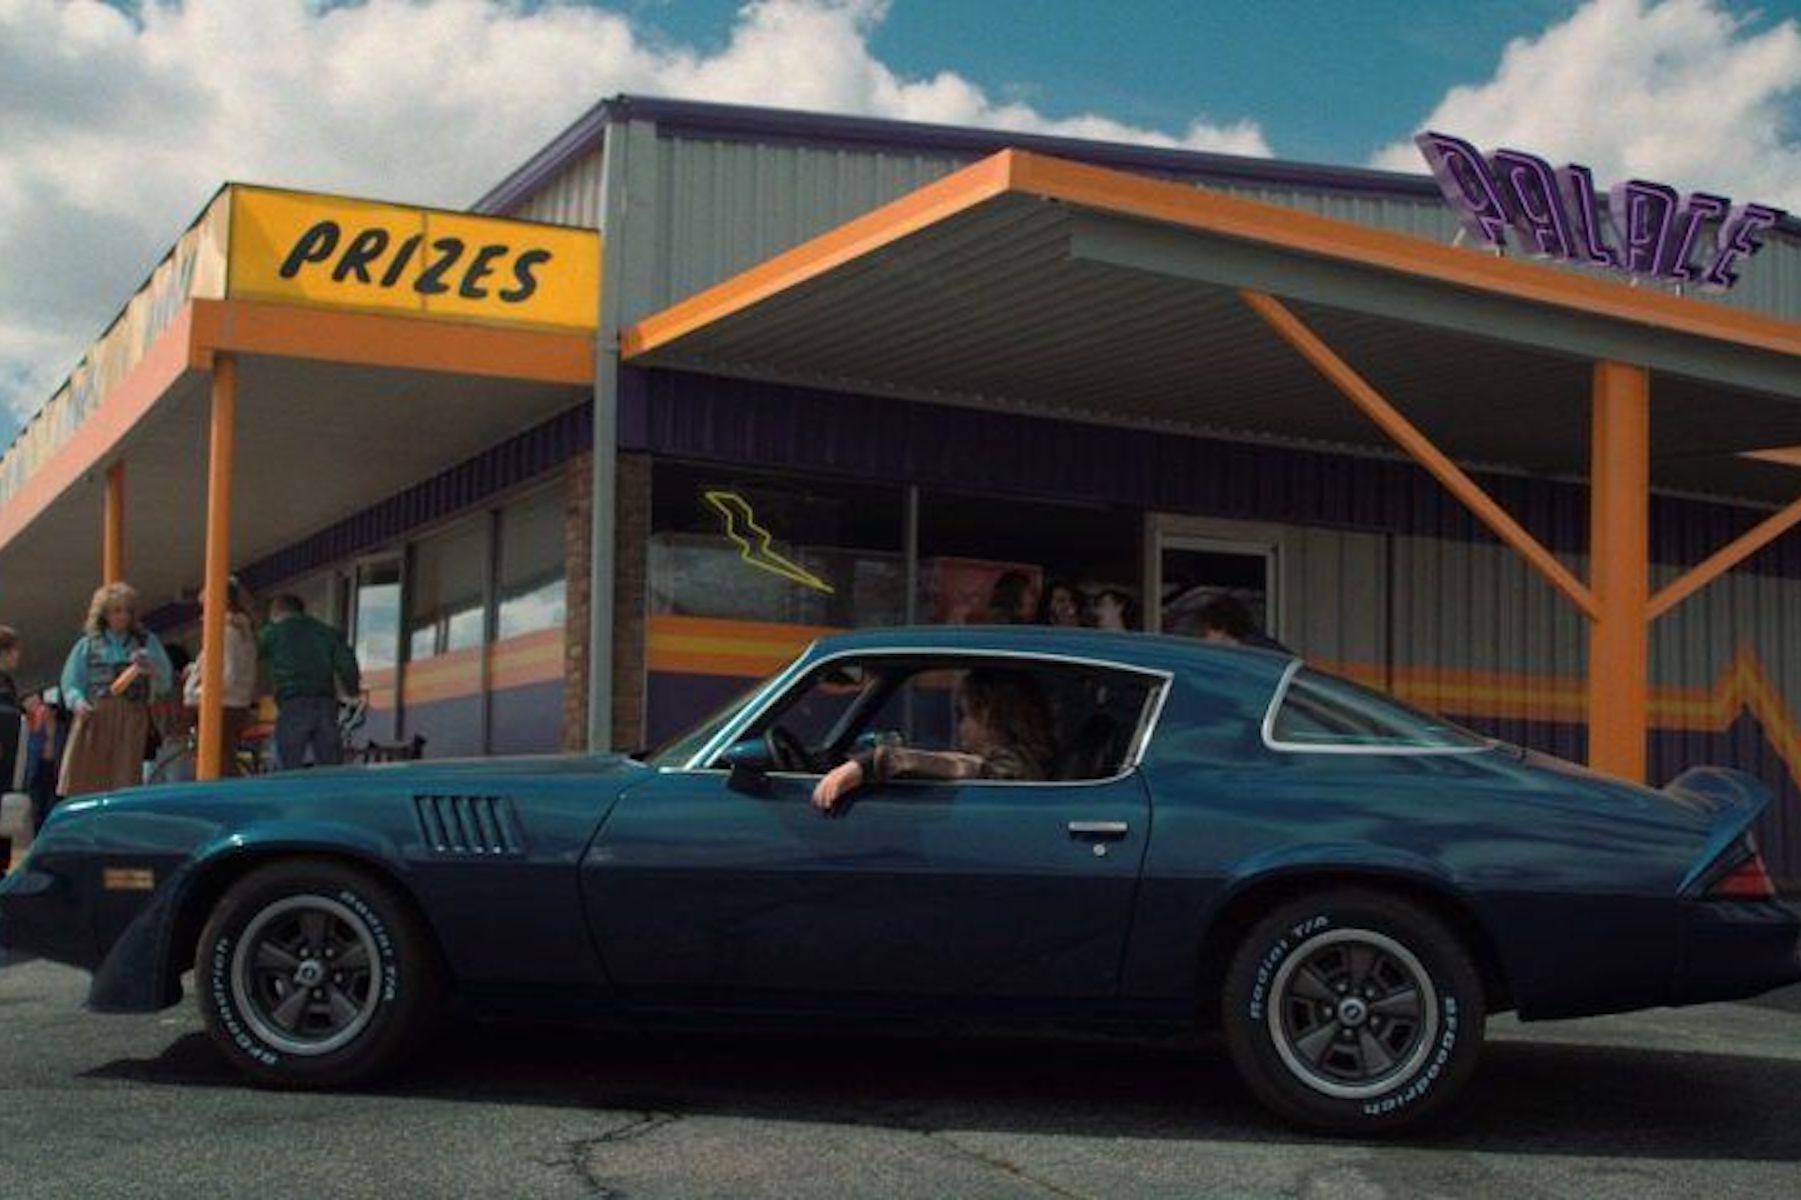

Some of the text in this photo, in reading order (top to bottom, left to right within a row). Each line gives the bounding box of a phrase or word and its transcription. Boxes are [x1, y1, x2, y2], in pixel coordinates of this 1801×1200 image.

[279, 219, 552, 303] PRIZES
[1414, 131, 1787, 291] PALACE
[1249, 914, 1330, 1020] Radial T/A
